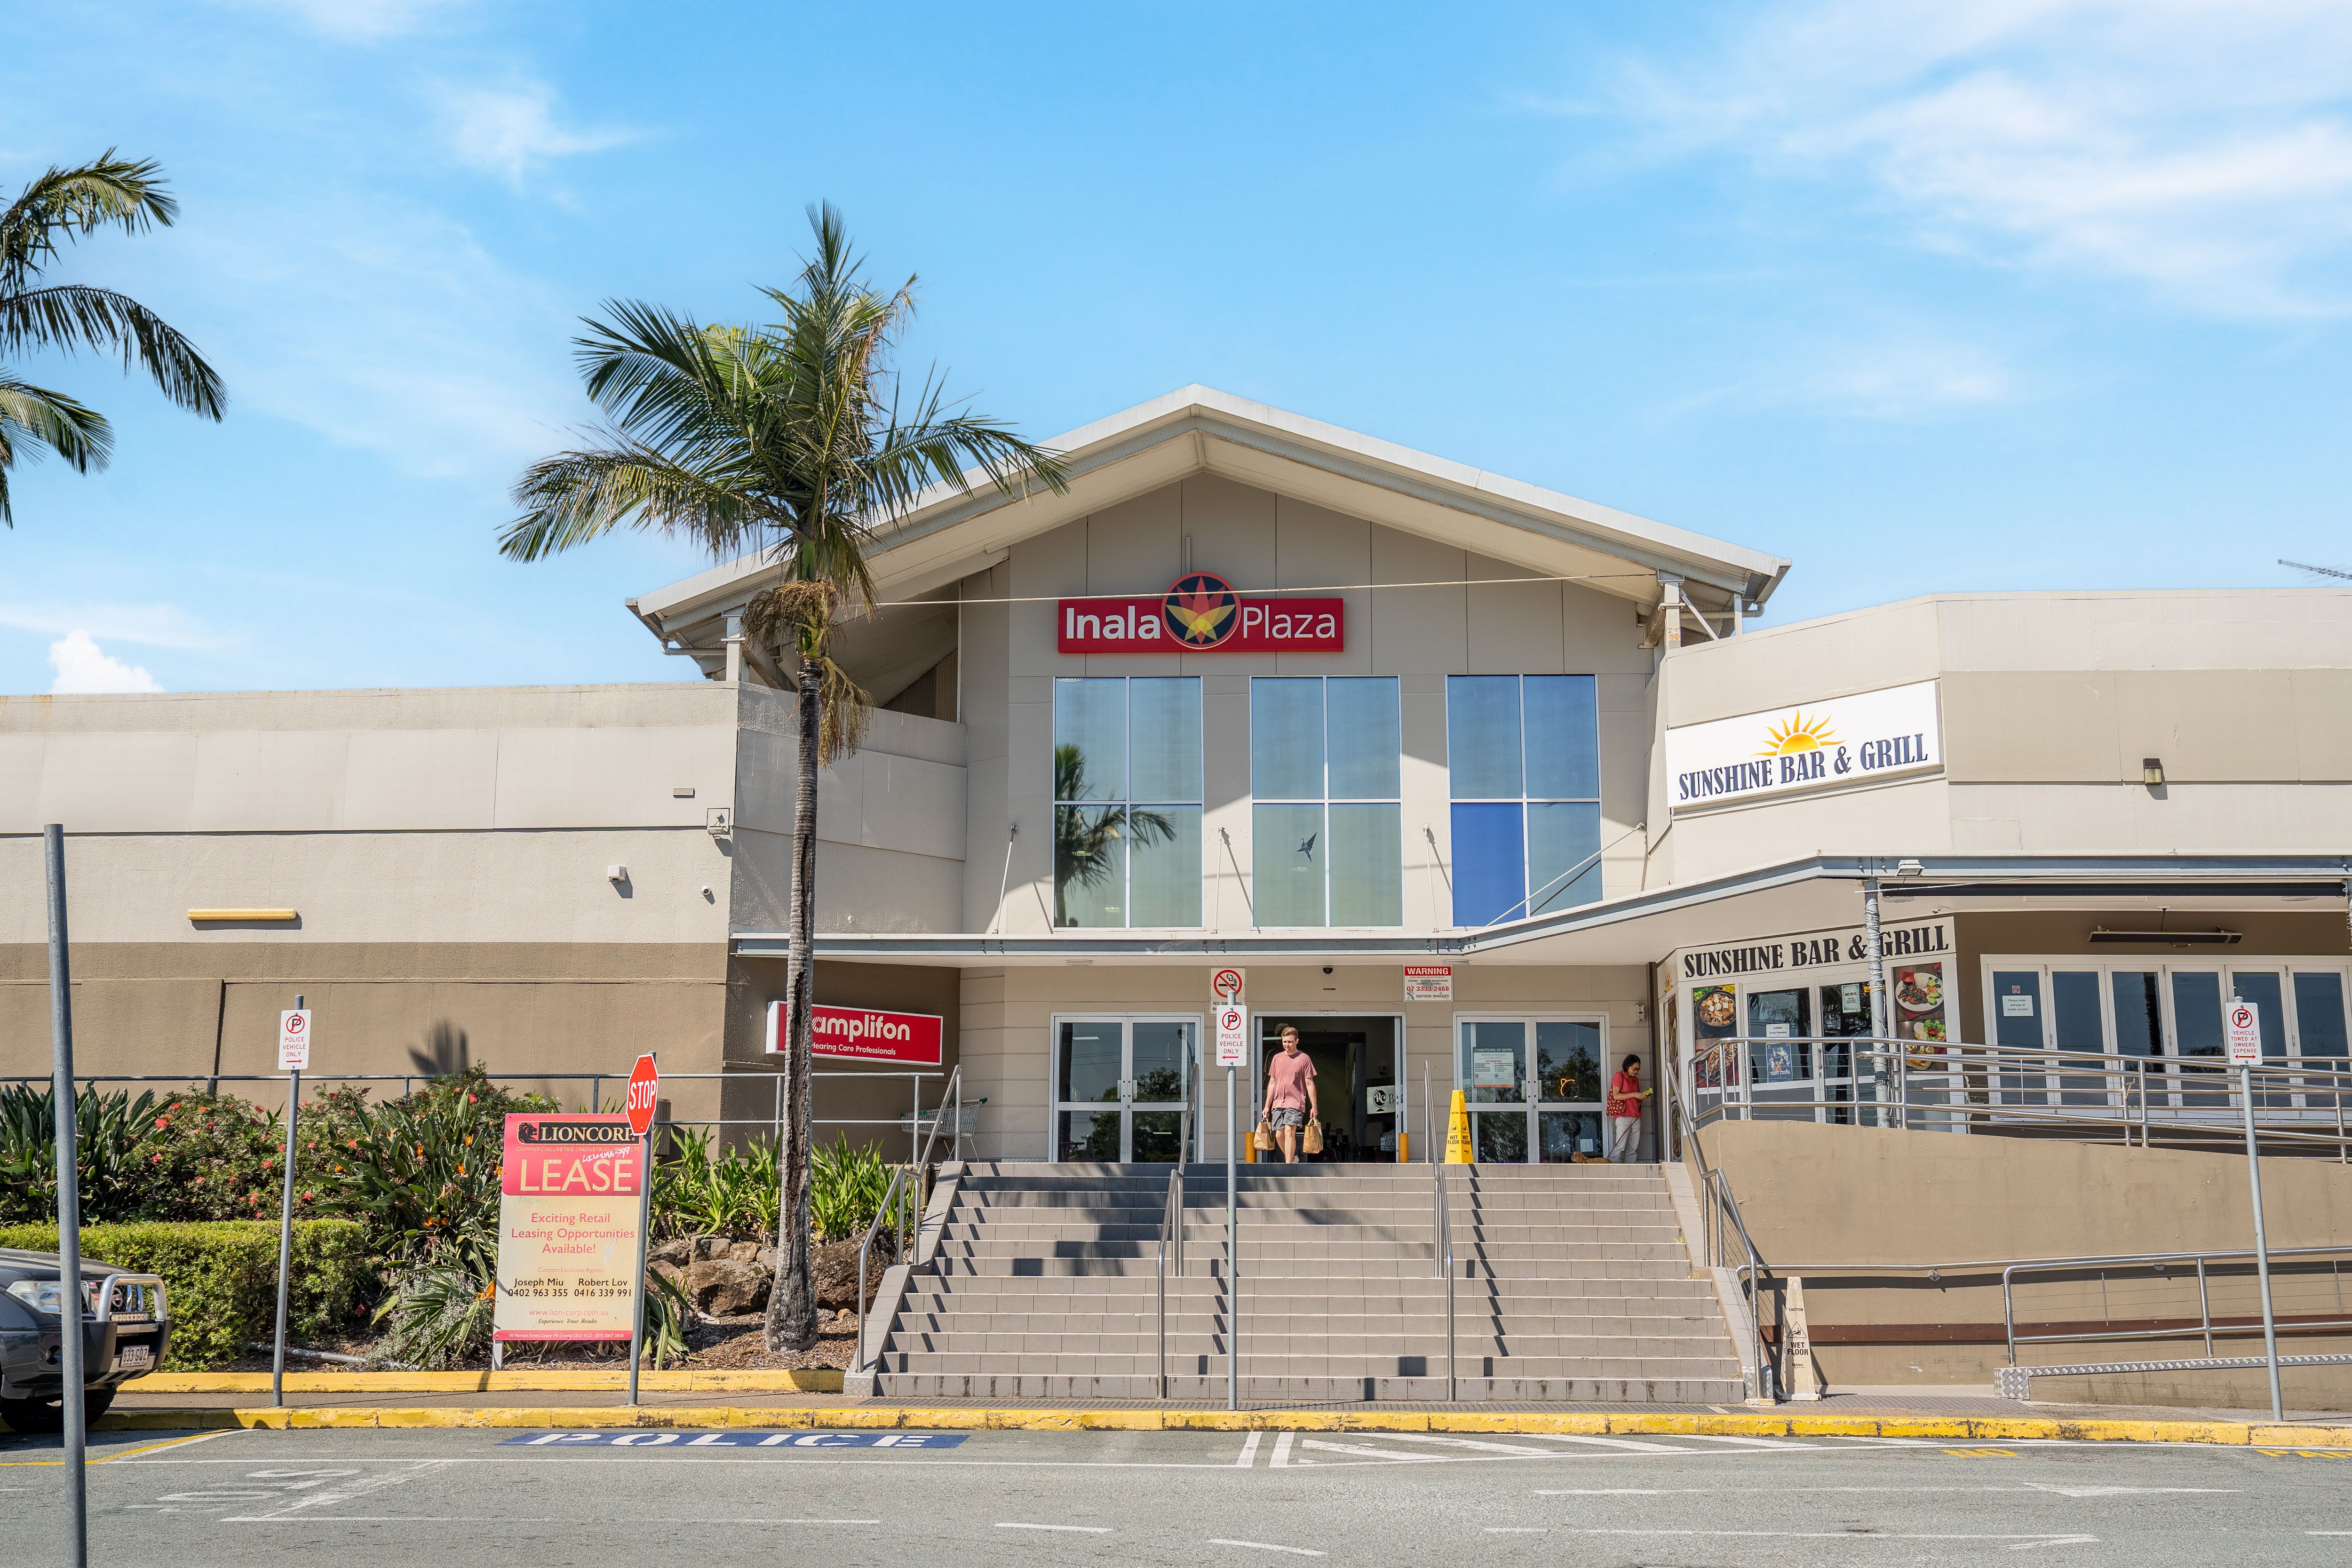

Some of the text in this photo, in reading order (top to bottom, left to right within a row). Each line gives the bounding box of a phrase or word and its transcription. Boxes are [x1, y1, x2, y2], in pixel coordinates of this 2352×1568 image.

[1066, 605, 1335, 639] Inala Plaza
[1679, 733, 1928, 800] SUNSHINE BAR & GRILL
[1685, 925, 1948, 978] SUNSHINE BAR & GRILL
[811, 1014, 909, 1042] amplifon
[811, 1042, 896, 1055] Hearing Care Professionals
[629, 1080, 656, 1110] STOP
[520, 1159, 633, 1192] LEASE
[531, 1213, 610, 1225] Exciting Retail
[511, 1228, 635, 1241] Leasing Opportunities
[541, 1243, 596, 1253] Available!
[514, 1278, 544, 1288] Joseph
[529, 1309, 609, 1317] www.lion-corp.com.au
[525, 1433, 933, 1447] POLICE
[1940, 1448, 2018, 1457] NO
